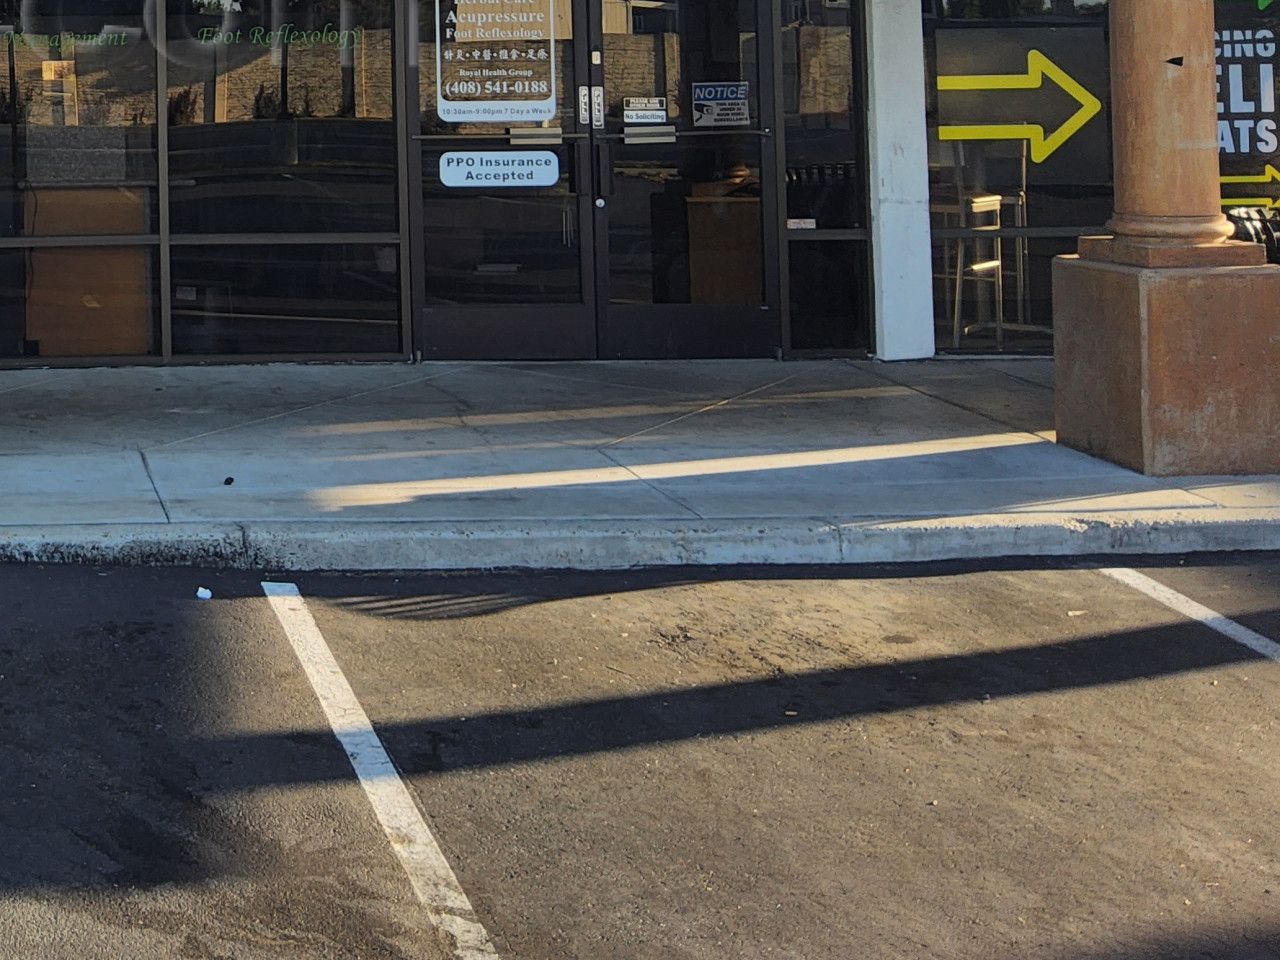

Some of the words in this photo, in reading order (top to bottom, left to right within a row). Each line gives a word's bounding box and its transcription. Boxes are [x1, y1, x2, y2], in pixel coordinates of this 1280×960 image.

[445, 10, 545, 26] Acupressure
[198, 27, 242, 44] Foot
[249, 23, 361, 49] Reflexology
[446, 28, 473, 39] Foot
[476, 28, 544, 40] Reflexology
[460, 68, 480, 77] Royal
[483, 68, 507, 76] Health
[508, 68, 533, 77] Group
[445, 80, 481, 96] (408)
[484, 80, 548, 93] 541-0188
[695, 86, 746, 98] NOTICE
[635, 112, 665, 121] Soliciting
[446, 157, 475, 167] PPO
[480, 157, 552, 167] Insurance
[465, 171, 534, 182] Accepted
